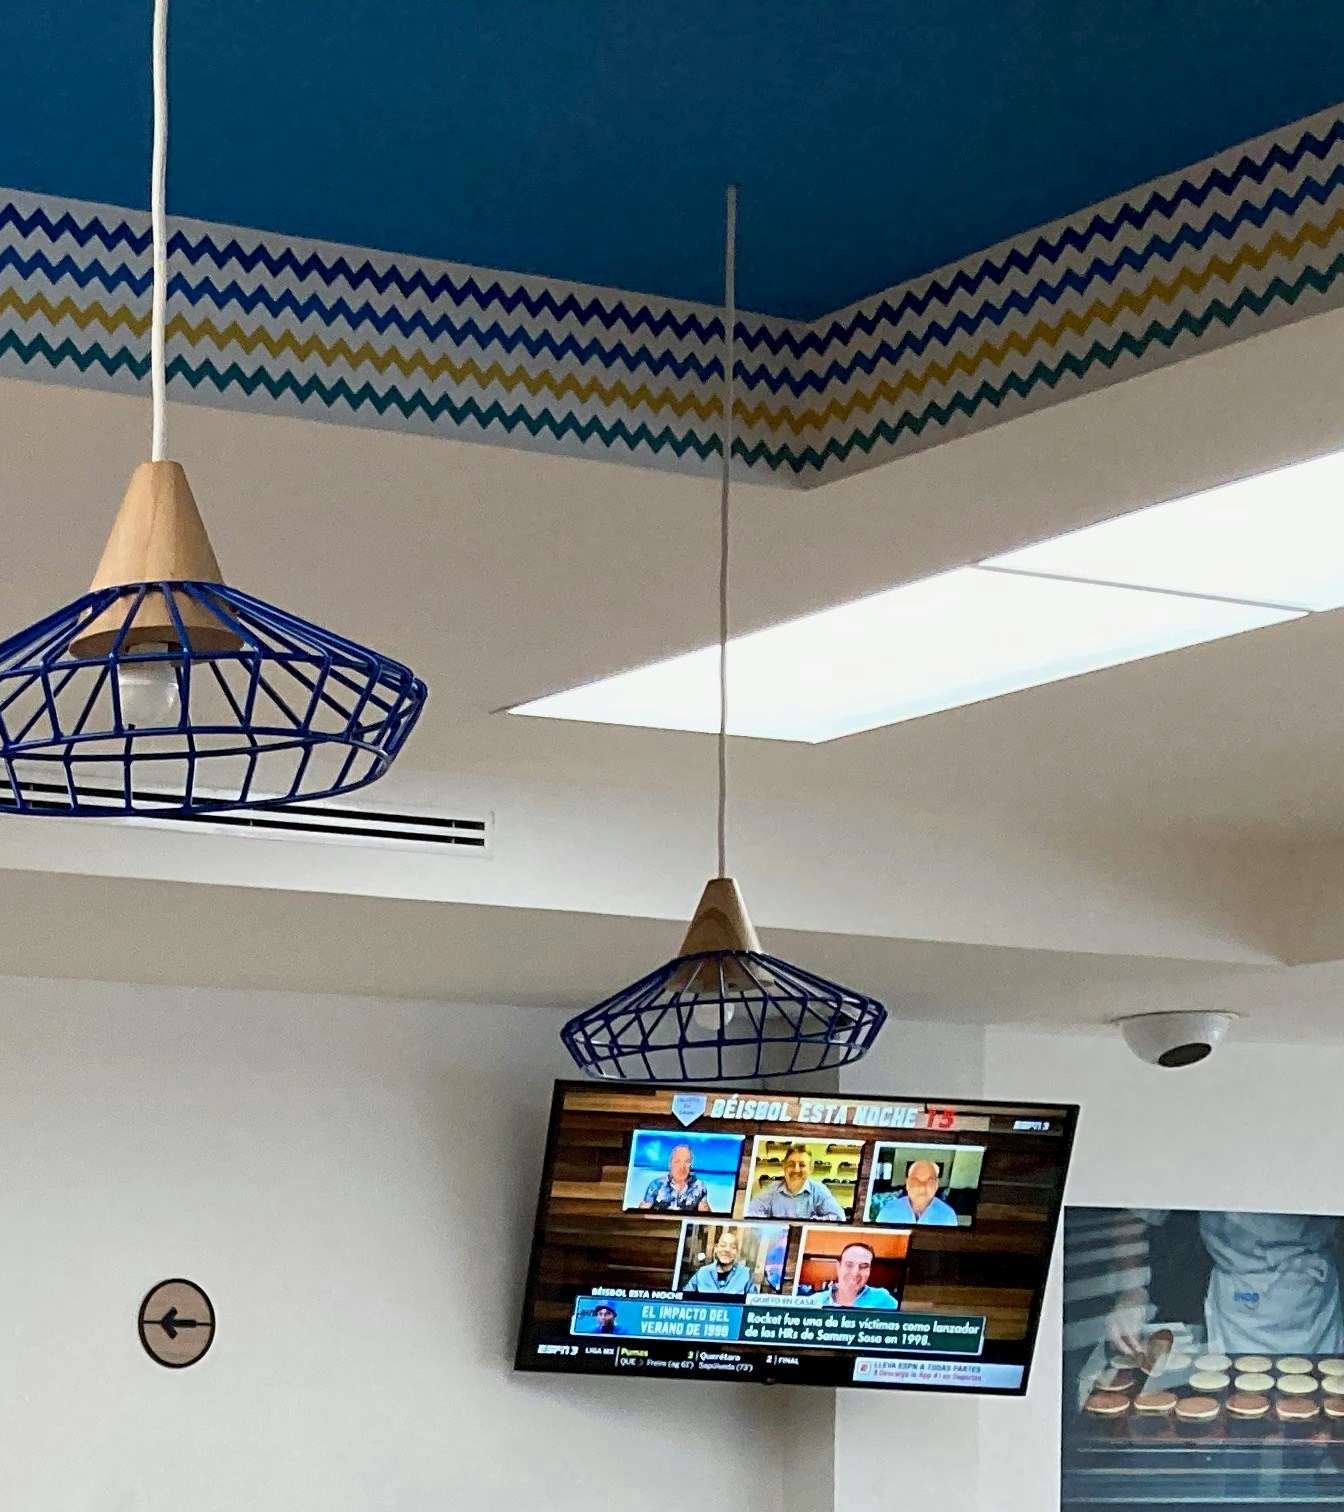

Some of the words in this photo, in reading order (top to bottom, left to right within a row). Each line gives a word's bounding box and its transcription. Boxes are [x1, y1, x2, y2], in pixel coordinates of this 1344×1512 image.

[710, 1093, 792, 1122] BÉISBOL
[798, 1102, 847, 1125] ESTA
[852, 1105, 918, 1128] NOCHE
[641, 1305, 656, 1319] EL
[659, 1306, 707, 1321] IMPACTO
[709, 1308, 729, 1322] DEL
[640, 1321, 684, 1336] VERANO
[685, 1322, 701, 1336] DE
[703, 1324, 729, 1338] 1998
[746, 1311, 783, 1325] Rocket
[783, 1312, 801, 1326] fue
[802, 1317, 823, 1327] una
[824, 1315, 839, 1328] de
[840, 1315, 856, 1329] las
[858, 1317, 900, 1331] víctimas
[902, 1322, 931, 1332] como
[932, 1320, 980, 1334] lanzador
[744, 1324, 759, 1337] de
[760, 1325, 776, 1338] las
[777, 1327, 799, 1339] HRs
[800, 1327, 815, 1339] de
[816, 1329, 856, 1345] Sammy
[857, 1331, 882, 1344] Sosa
[884, 1335, 898, 1344] en
[901, 1333, 931, 1347] 1998.
[621, 1347, 648, 1357] Pumas
[620, 1357, 637, 1367] QUE
